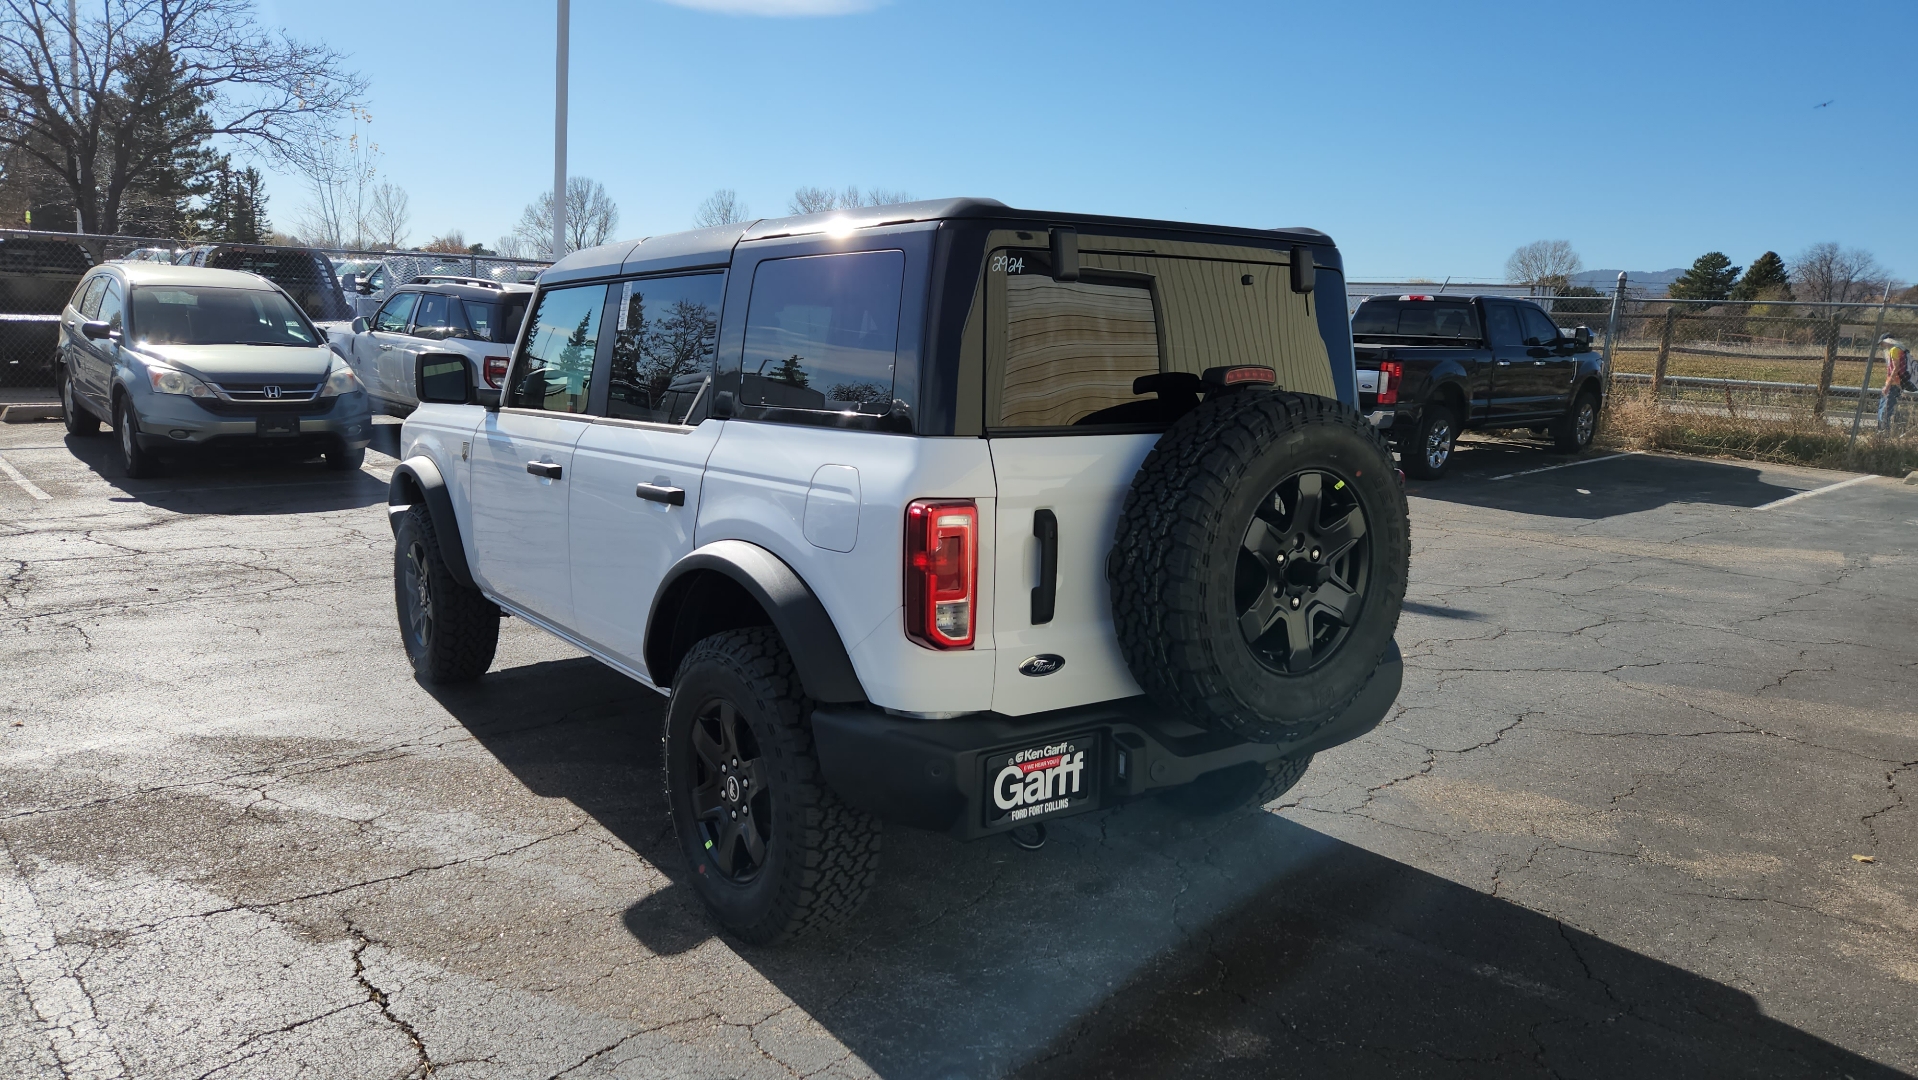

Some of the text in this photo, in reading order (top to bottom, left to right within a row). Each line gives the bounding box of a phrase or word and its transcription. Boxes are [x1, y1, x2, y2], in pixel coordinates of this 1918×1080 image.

[992, 256, 1025, 274] 2924
[1371, 476, 1401, 606] GENERAL
[1031, 659, 1056, 672] Ford
[1024, 749, 1043, 761] Ken
[1044, 742, 1068, 756] Garff
[993, 751, 1084, 810] Garff
[1011, 798, 1069, 821] FORD FORT COLLINS
